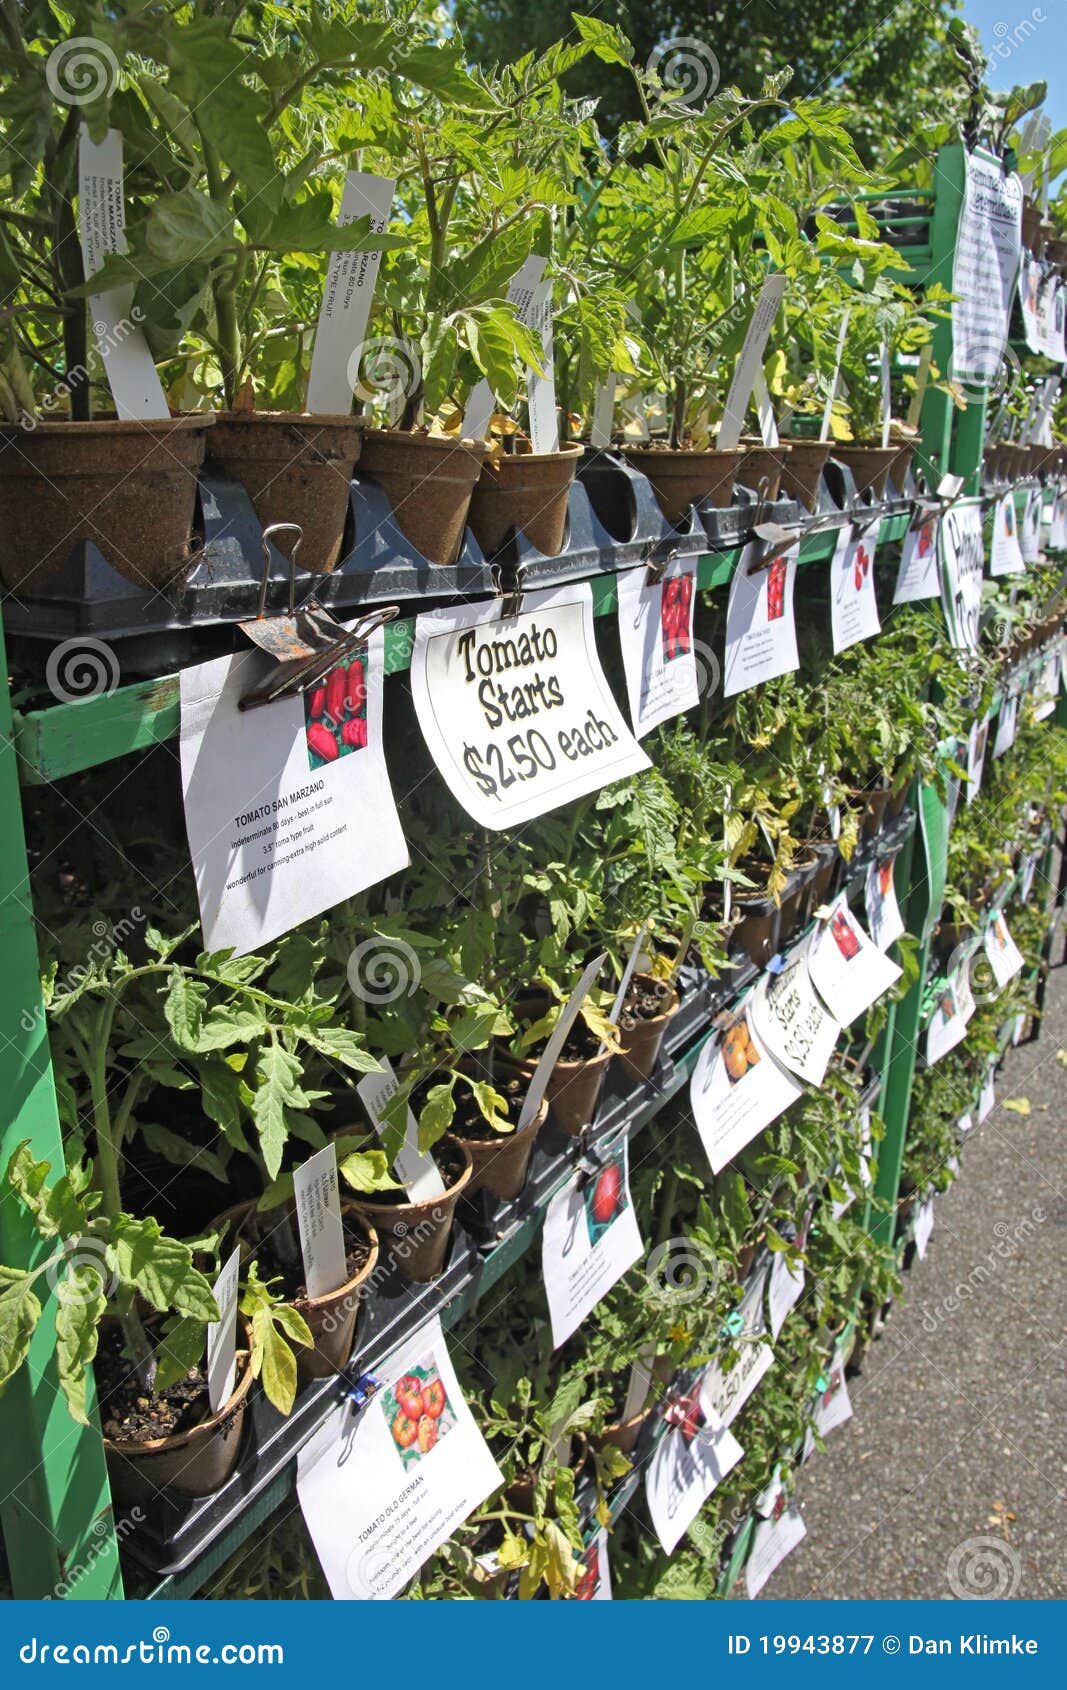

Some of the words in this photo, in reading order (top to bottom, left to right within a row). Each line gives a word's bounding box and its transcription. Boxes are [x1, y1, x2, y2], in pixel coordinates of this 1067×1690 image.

[115, 180, 123, 228] TOMATO
[331, 264, 341, 288] TYPE
[326, 290, 336, 318] FRUIT
[457, 622, 559, 682] Tomato
[478, 672, 565, 731] Starts
[463, 728, 557, 802] $2.50
[558, 708, 619, 762] each
[231, 825, 272, 850] indeterminate
[272, 821, 280, 832] 80
[280, 814, 294, 828] days
[297, 807, 311, 820] best
[323, 796, 334, 806] sun
[234, 804, 272, 829] TOMATO
[271, 796, 289, 813] SAN
[289, 779, 325, 805] MARZANO
[226, 871, 258, 891] wonderful
[257, 862, 267, 876] for
[304, 838, 317, 852] high
[317, 833, 329, 847] solid
[329, 824, 348, 840] content
[275, 836, 290, 849] roma
[290, 829, 303, 843] type
[302, 823, 315, 835] fruit
[358, 1513, 386, 1543] TOMATO
[385, 1500, 399, 1516] OLD
[398, 1474, 424, 1504] GERMAN
[400, 1507, 411, 1519] days
